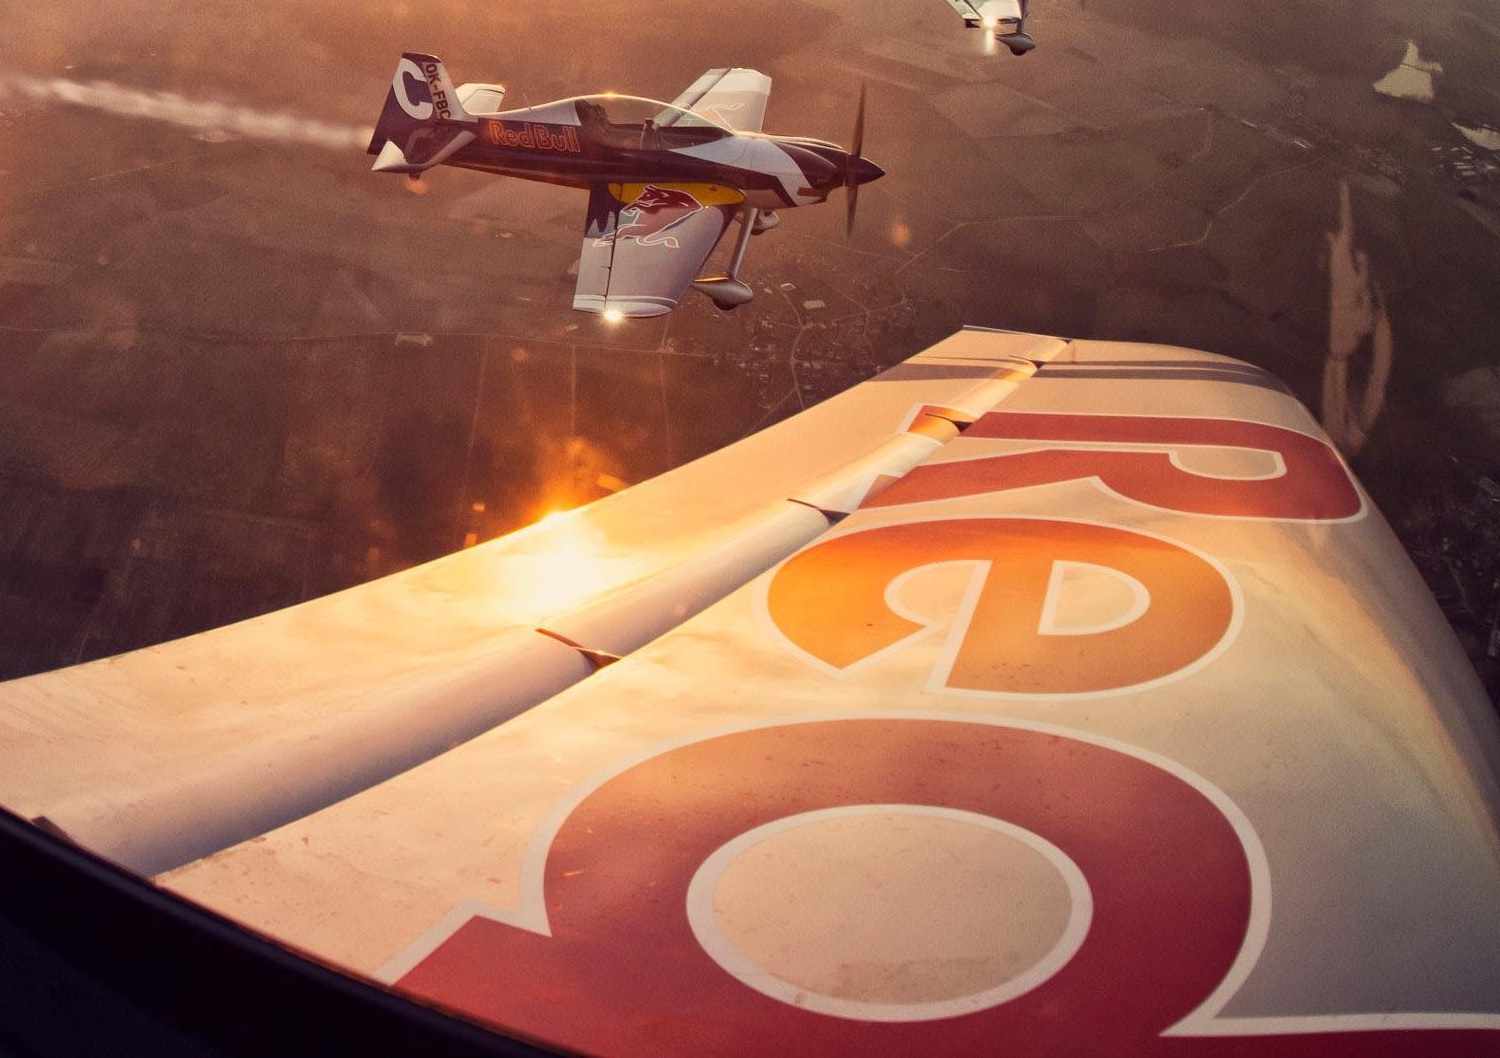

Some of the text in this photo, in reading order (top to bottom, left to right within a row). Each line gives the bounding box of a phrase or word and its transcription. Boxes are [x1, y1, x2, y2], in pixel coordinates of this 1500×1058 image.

[392, 57, 434, 120] C
[424, 62, 451, 120] OK-FBC
[488, 120, 581, 153] Red Bull
[378, 403, 1500, 1058] Red
